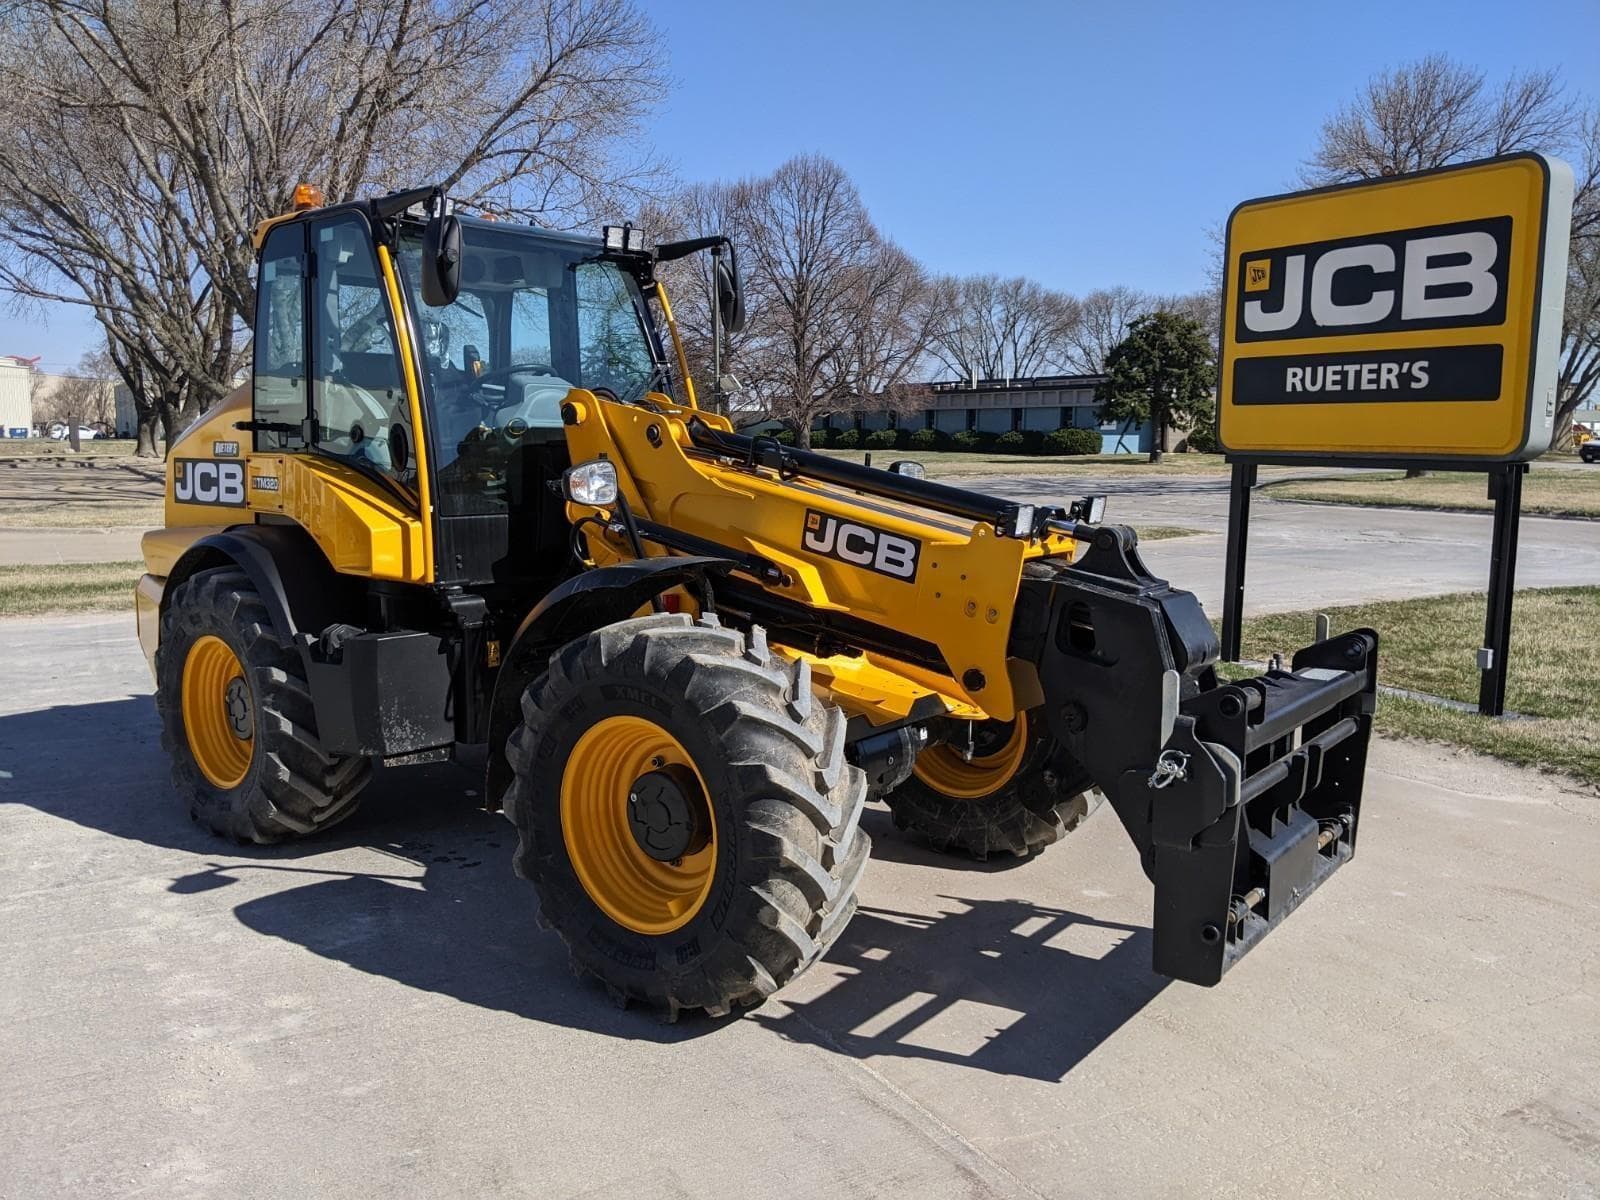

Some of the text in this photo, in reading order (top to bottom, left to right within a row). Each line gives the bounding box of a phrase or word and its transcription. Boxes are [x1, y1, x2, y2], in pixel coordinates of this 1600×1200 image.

[1244, 231, 1498, 332] JCB
[1286, 361, 1429, 393] RUETER'S
[176, 462, 244, 503] JCB
[805, 518, 916, 578] JCB
